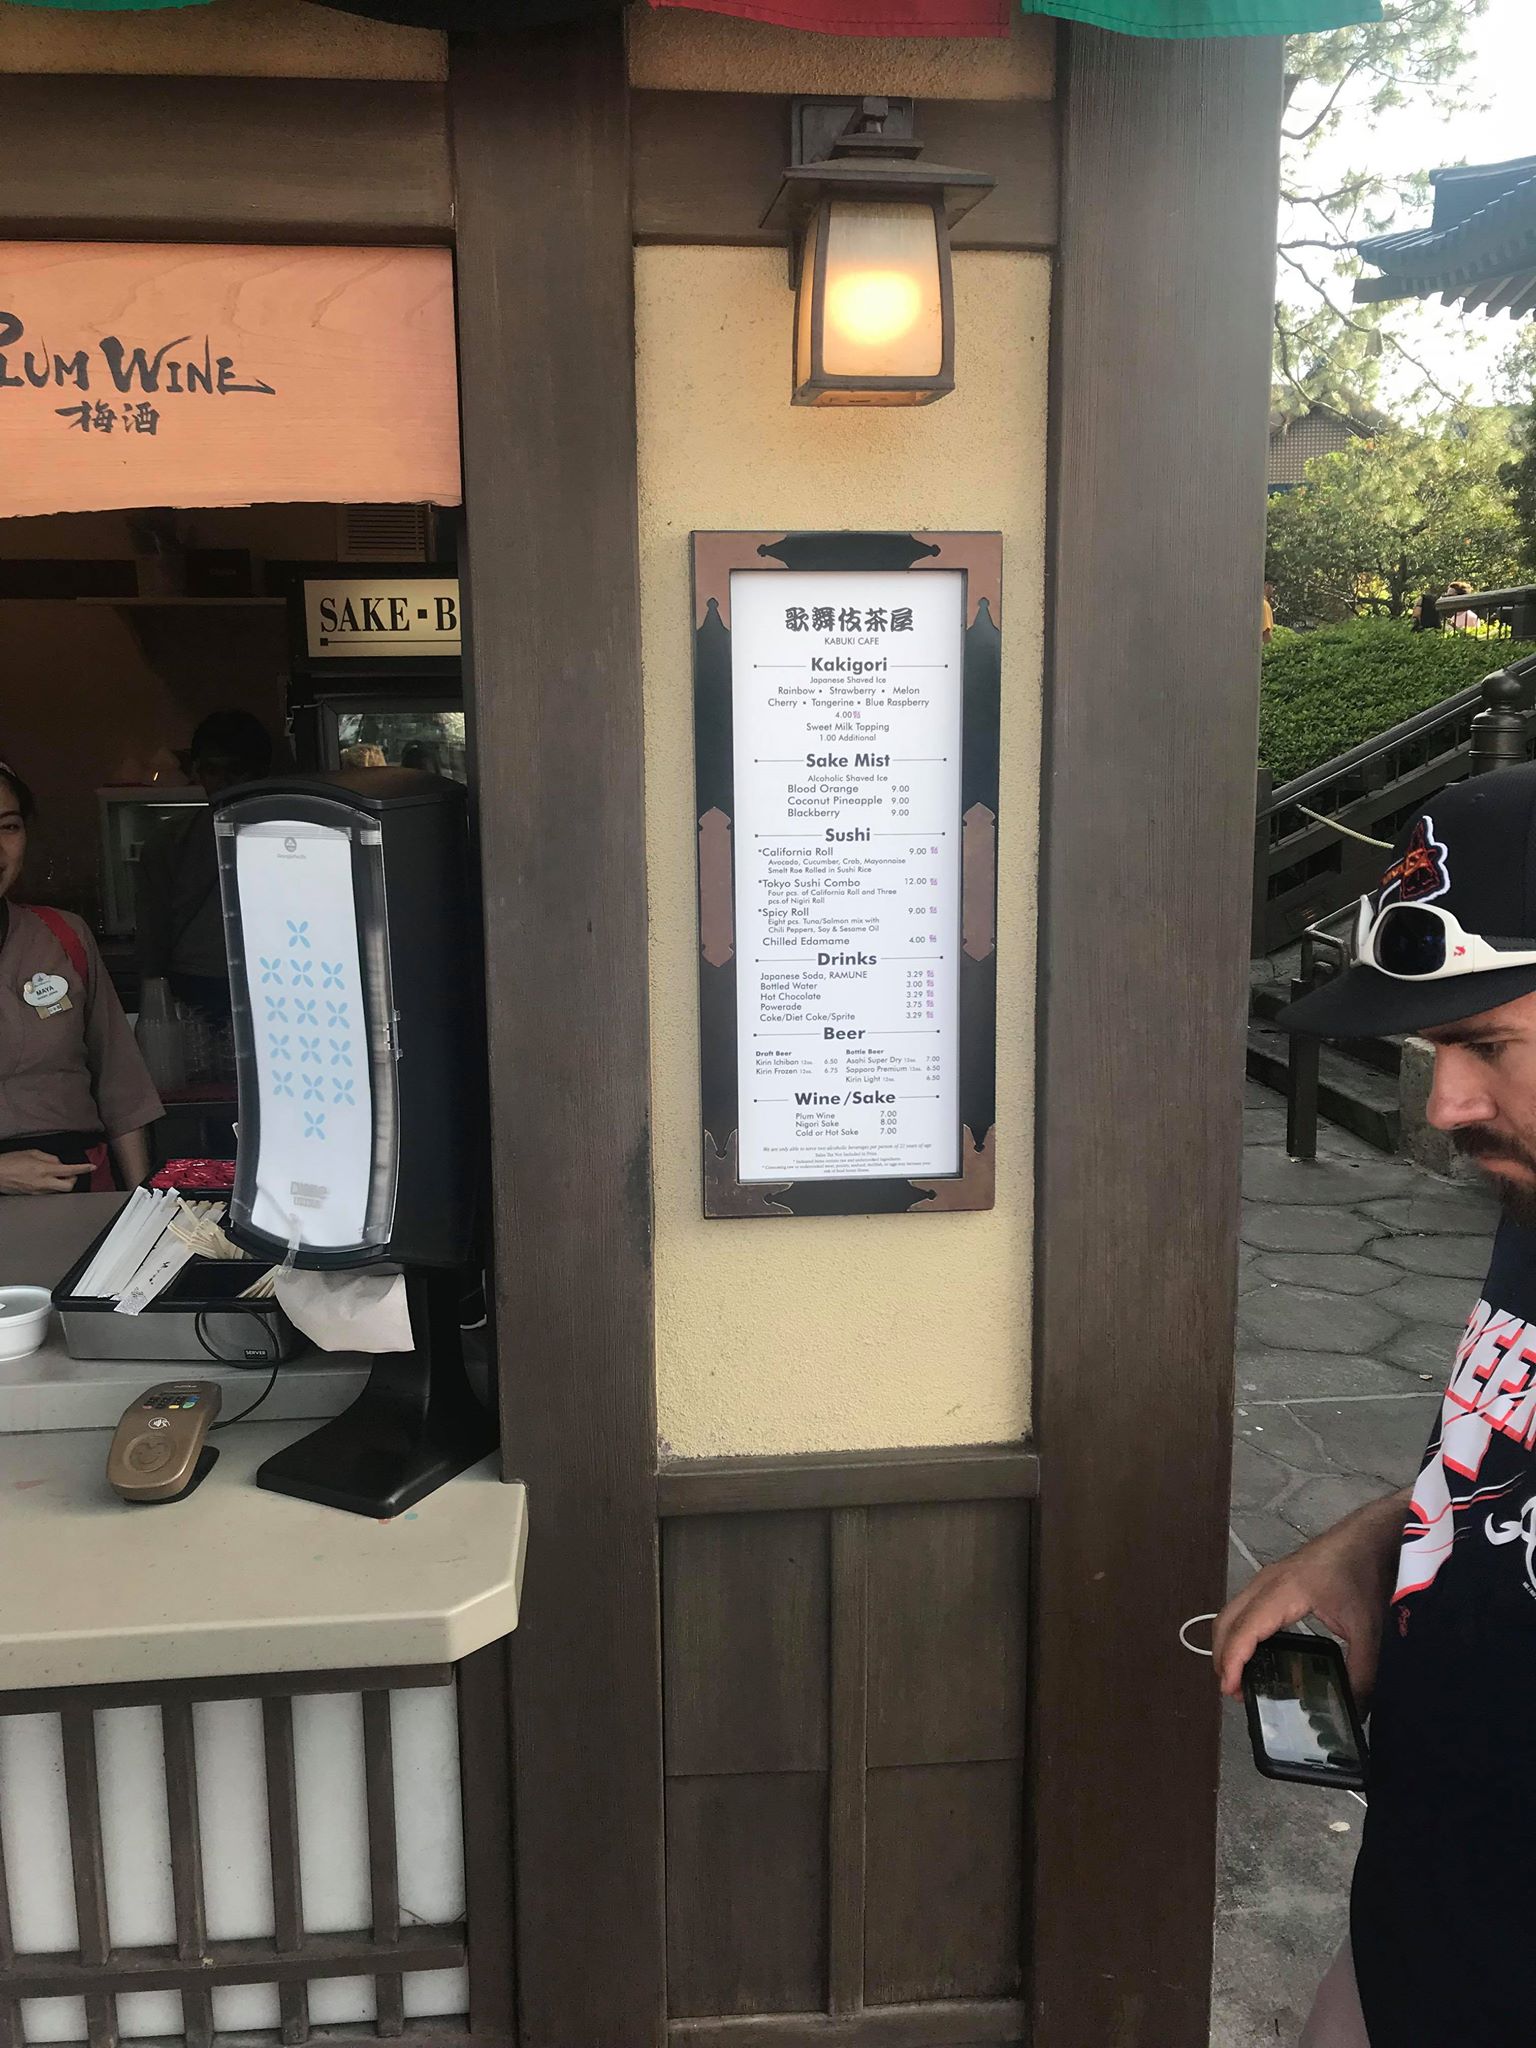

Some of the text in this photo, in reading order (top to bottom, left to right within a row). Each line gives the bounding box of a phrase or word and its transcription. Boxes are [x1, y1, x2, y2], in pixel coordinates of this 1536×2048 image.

[99, 334, 276, 395] WINE
[55, 399, 160, 436] 梅酒
[319, 597, 410, 632] SAKE
[785, 606, 914, 632] 歌舞伎茶屋
[824, 637, 879, 645] KABUKI CAFE
[811, 657, 887, 675] Kakigori
[810, 676, 844, 684] Japanese
[847, 676, 874, 684] Shaved
[778, 687, 815, 695] Rainbow
[829, 687, 876, 696] Strawberry
[768, 699, 797, 708] Cherry
[812, 699, 854, 708] Tangerine
[887, 699, 929, 708] Raspberry
[806, 723, 889, 732] Sweet Milk Topping
[806, 754, 890, 767] Sake Mist
[788, 785, 816, 793] Blood
[820, 785, 858, 795] Orange
[788, 797, 830, 805] Coconut
[834, 797, 882, 807] Pineapple
[788, 808, 840, 819] Blackberry
[825, 827, 870, 842] Sushi
[816, 848, 834, 856] Roll
[768, 858, 800, 866] Avocado,
[803, 858, 840, 866] Cucumber,
[864, 857, 906, 866] Mayonnaise
[794, 879, 821, 887] Sushi
[824, 879, 860, 887] Combo
[791, 897, 810, 905] Nigiri
[792, 908, 809, 916] Roll
[803, 917, 848, 925] Tuna/Salmon
[818, 926, 830, 934] Soy
[763, 937, 797, 946] Chilled
[801, 937, 849, 945] Edamame
[818, 952, 877, 966] Drinks
[760, 972, 800, 981] Japanese
[802, 972, 827, 980] Soda,
[829, 971, 867, 979] RAMUNE
[761, 982, 790, 990] Bottled
[792, 982, 817, 990] Water
[36, 986, 54, 996] MAYA
[778, 992, 821, 1000] Chocolate
[761, 1003, 802, 1011] Powerade
[760, 1013, 803, 1022] Coke/Diet
[805, 1012, 855, 1022] Coke/Sprite
[824, 1027, 865, 1040] Beer
[756, 1058, 771, 1066] Kirin
[868, 1057, 888, 1065] Super
[890, 1056, 902, 1064] Dry
[774, 1067, 797, 1075] Frozen
[846, 1066, 874, 1074] Sapporo
[864, 1075, 880, 1084] Light
[796, 1112, 814, 1120] Plum
[796, 1120, 819, 1129] Nigori
[826, 1128, 839, 1136] Hot
